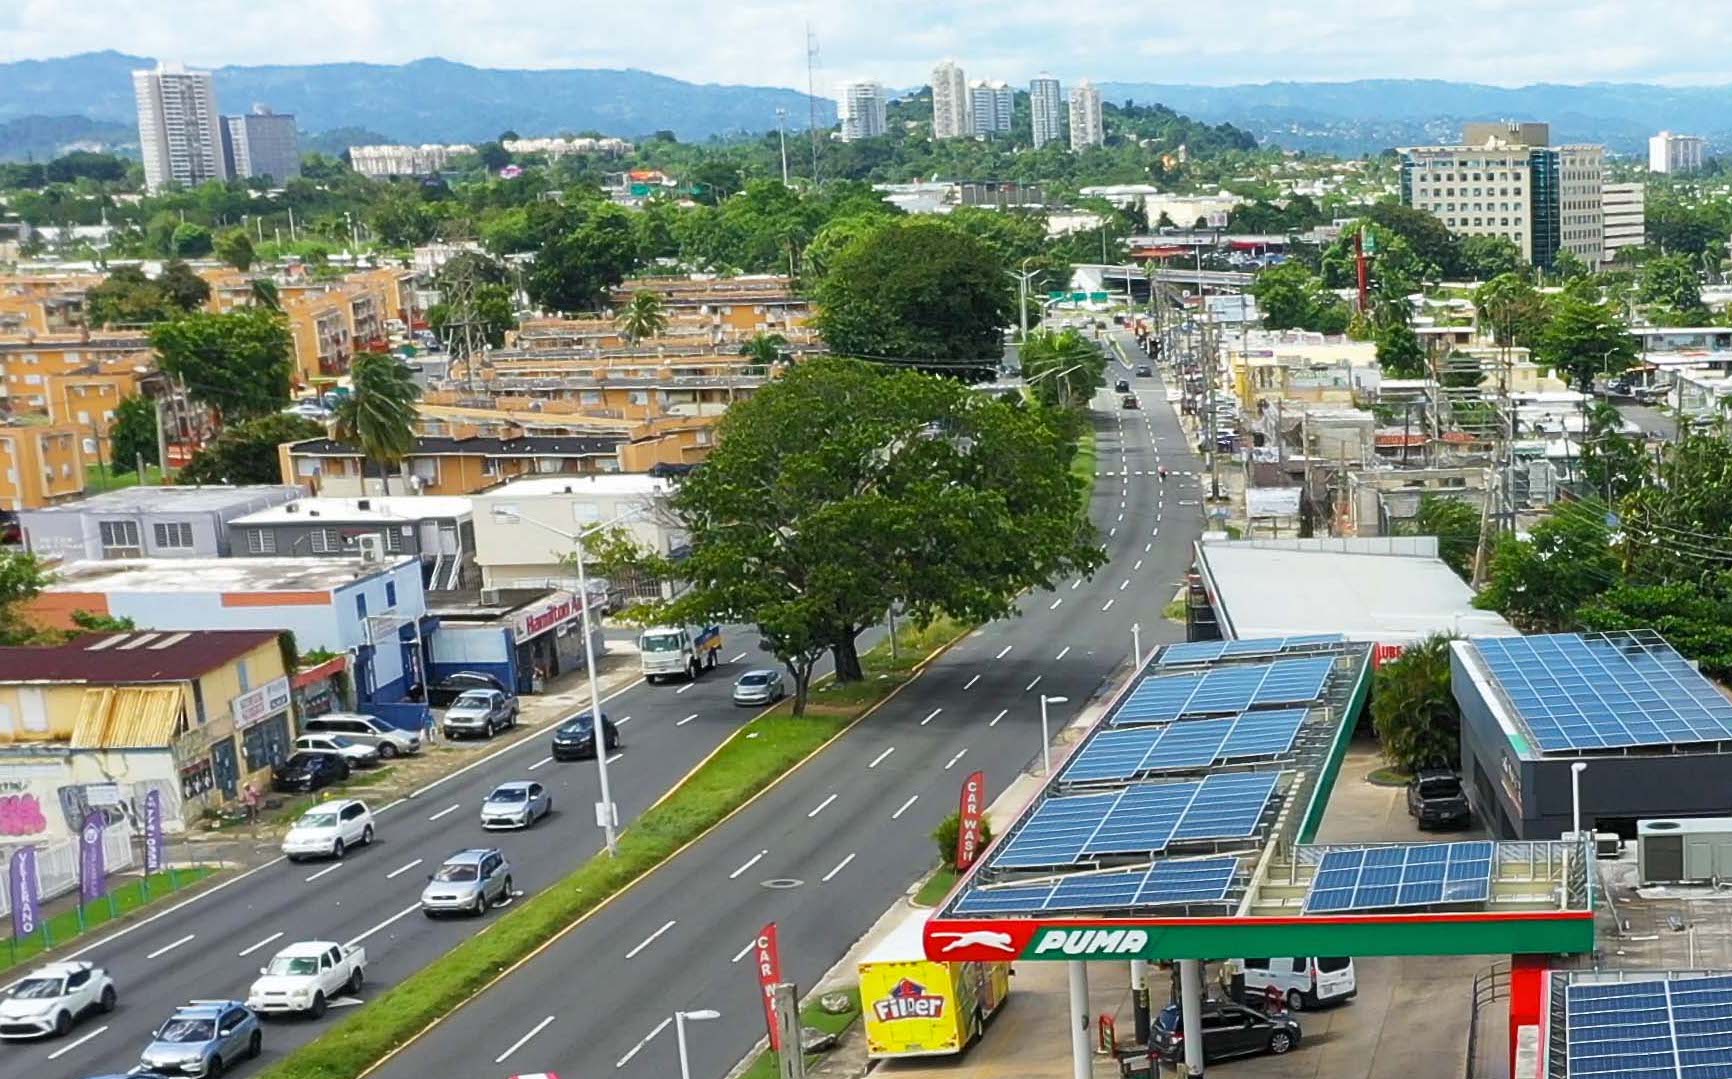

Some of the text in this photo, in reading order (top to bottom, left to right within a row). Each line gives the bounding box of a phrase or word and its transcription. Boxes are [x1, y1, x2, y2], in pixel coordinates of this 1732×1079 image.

[967, 781, 977, 814] CAR
[963, 819, 977, 861] WASH
[757, 936, 773, 977] CAR
[1034, 929, 1149, 955] PUMA
